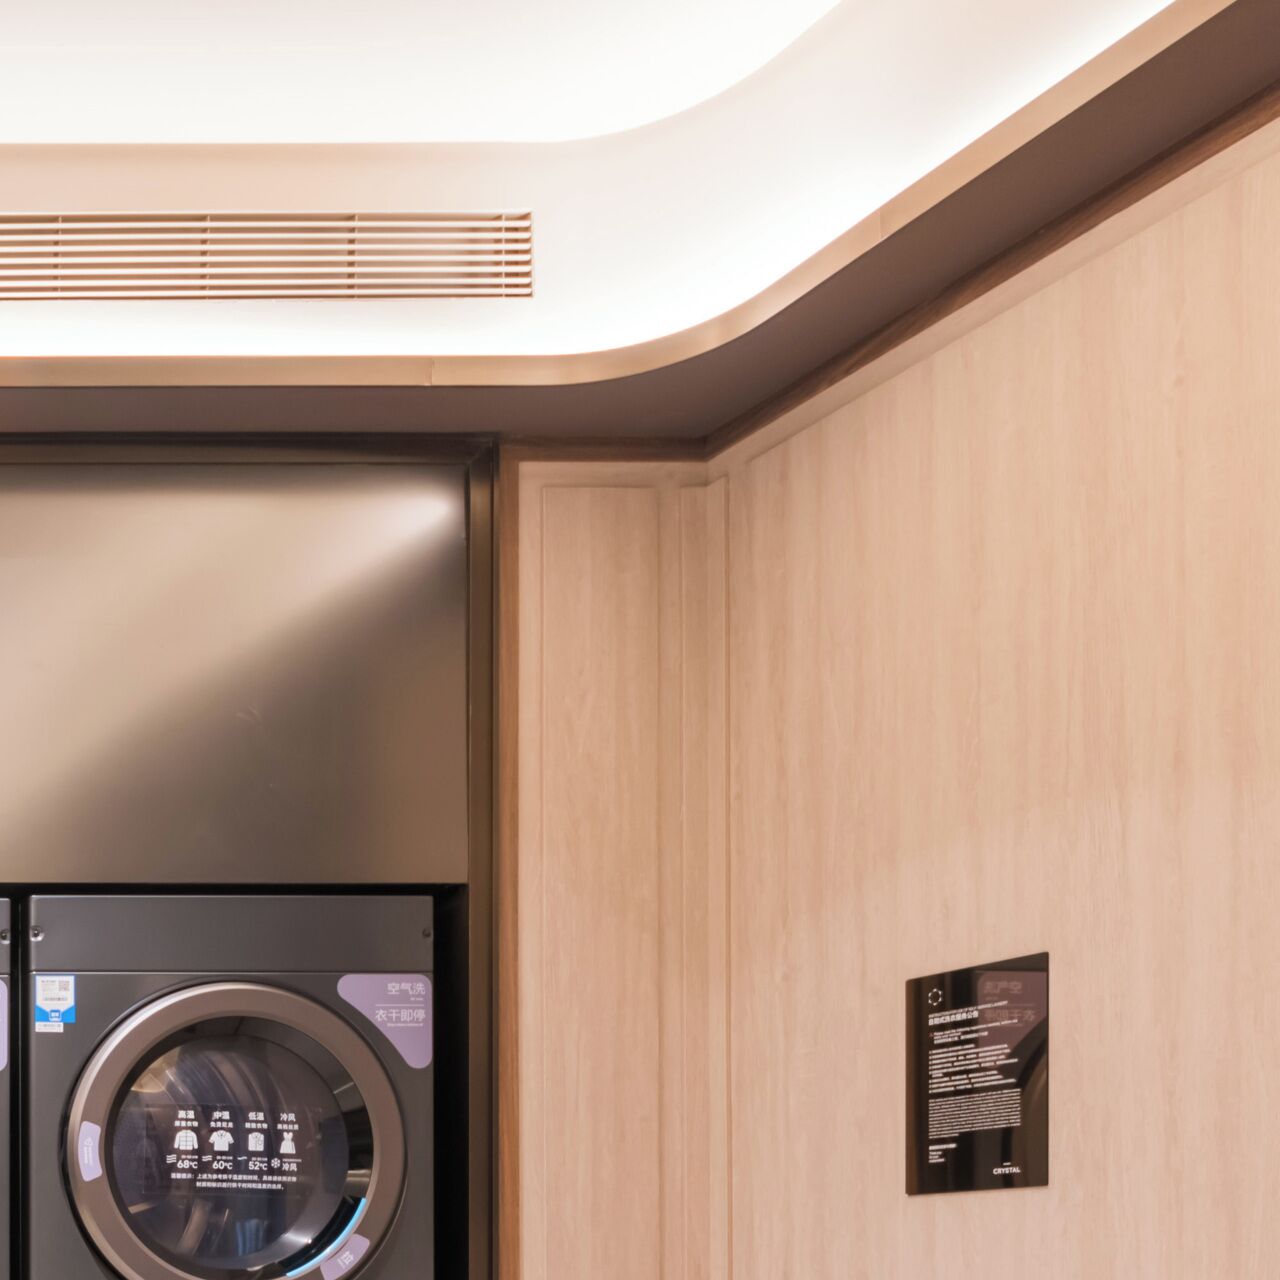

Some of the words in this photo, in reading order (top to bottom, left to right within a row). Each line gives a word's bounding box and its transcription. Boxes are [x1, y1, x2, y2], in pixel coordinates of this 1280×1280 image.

[387, 983, 425, 995] 空气洗
[375, 1009, 425, 1022] 衣干即停
[178, 1110, 195, 1118] 高温
[214, 1111, 230, 1119] 中温
[248, 1112, 264, 1120] 低温
[280, 1114, 296, 1122] 冷风
[992, 1166, 1021, 1176] CRYSTAL
